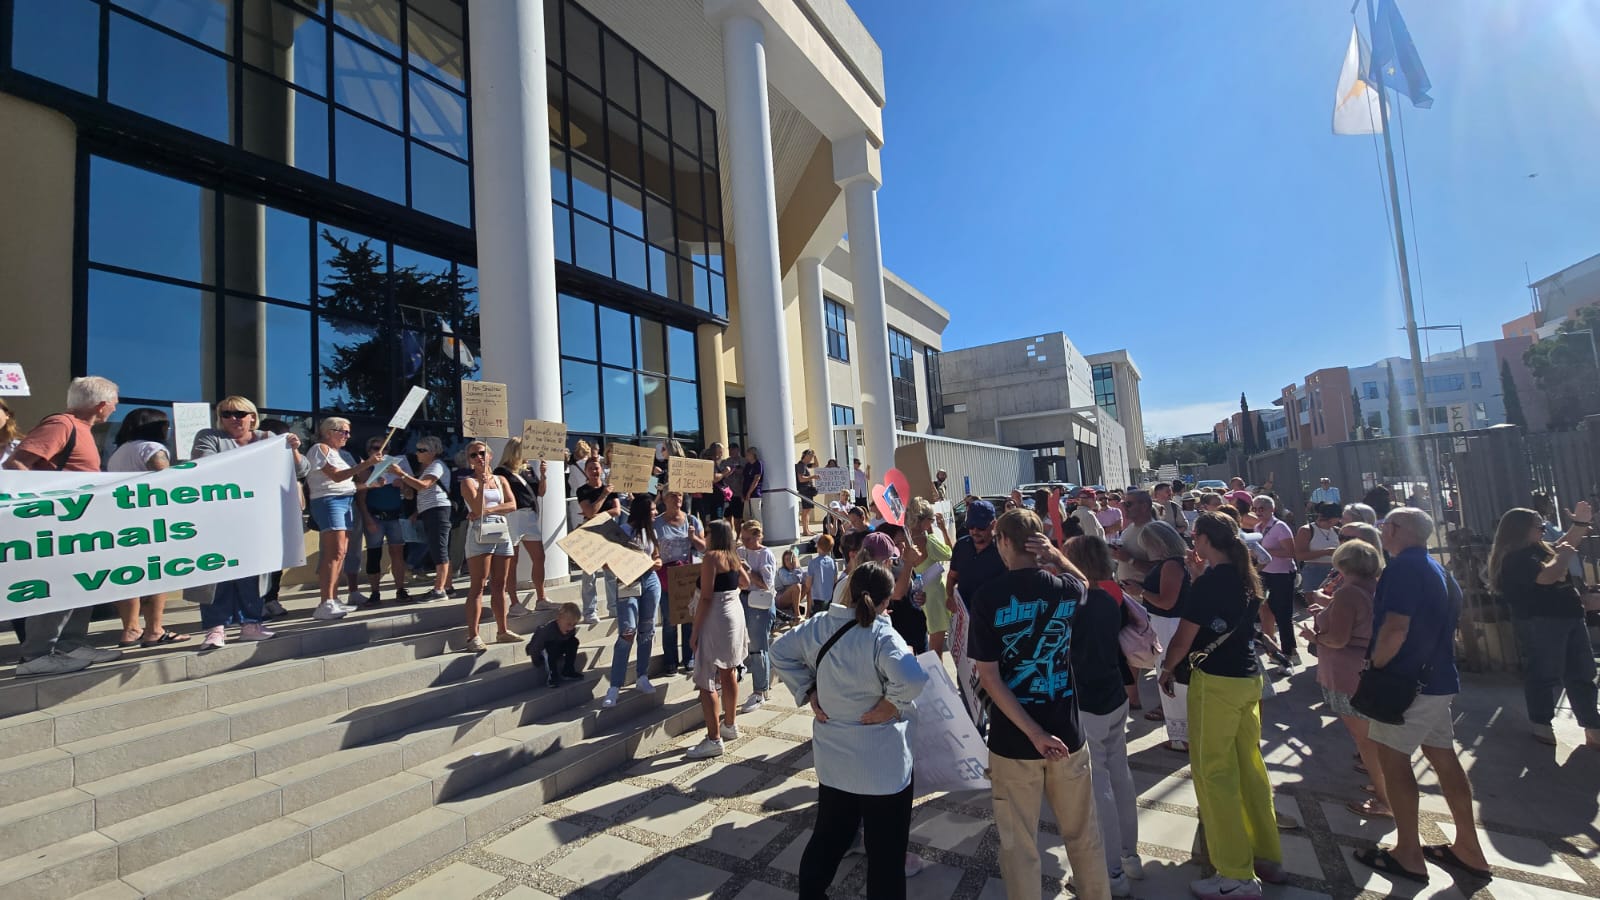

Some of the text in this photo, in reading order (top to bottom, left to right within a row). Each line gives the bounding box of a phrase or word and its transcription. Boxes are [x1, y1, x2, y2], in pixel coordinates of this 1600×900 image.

[1, 493, 94, 521] ay
[112, 483, 255, 508] them.
[683, 478, 712, 489] DECISION
[7, 552, 240, 602] a voice.
